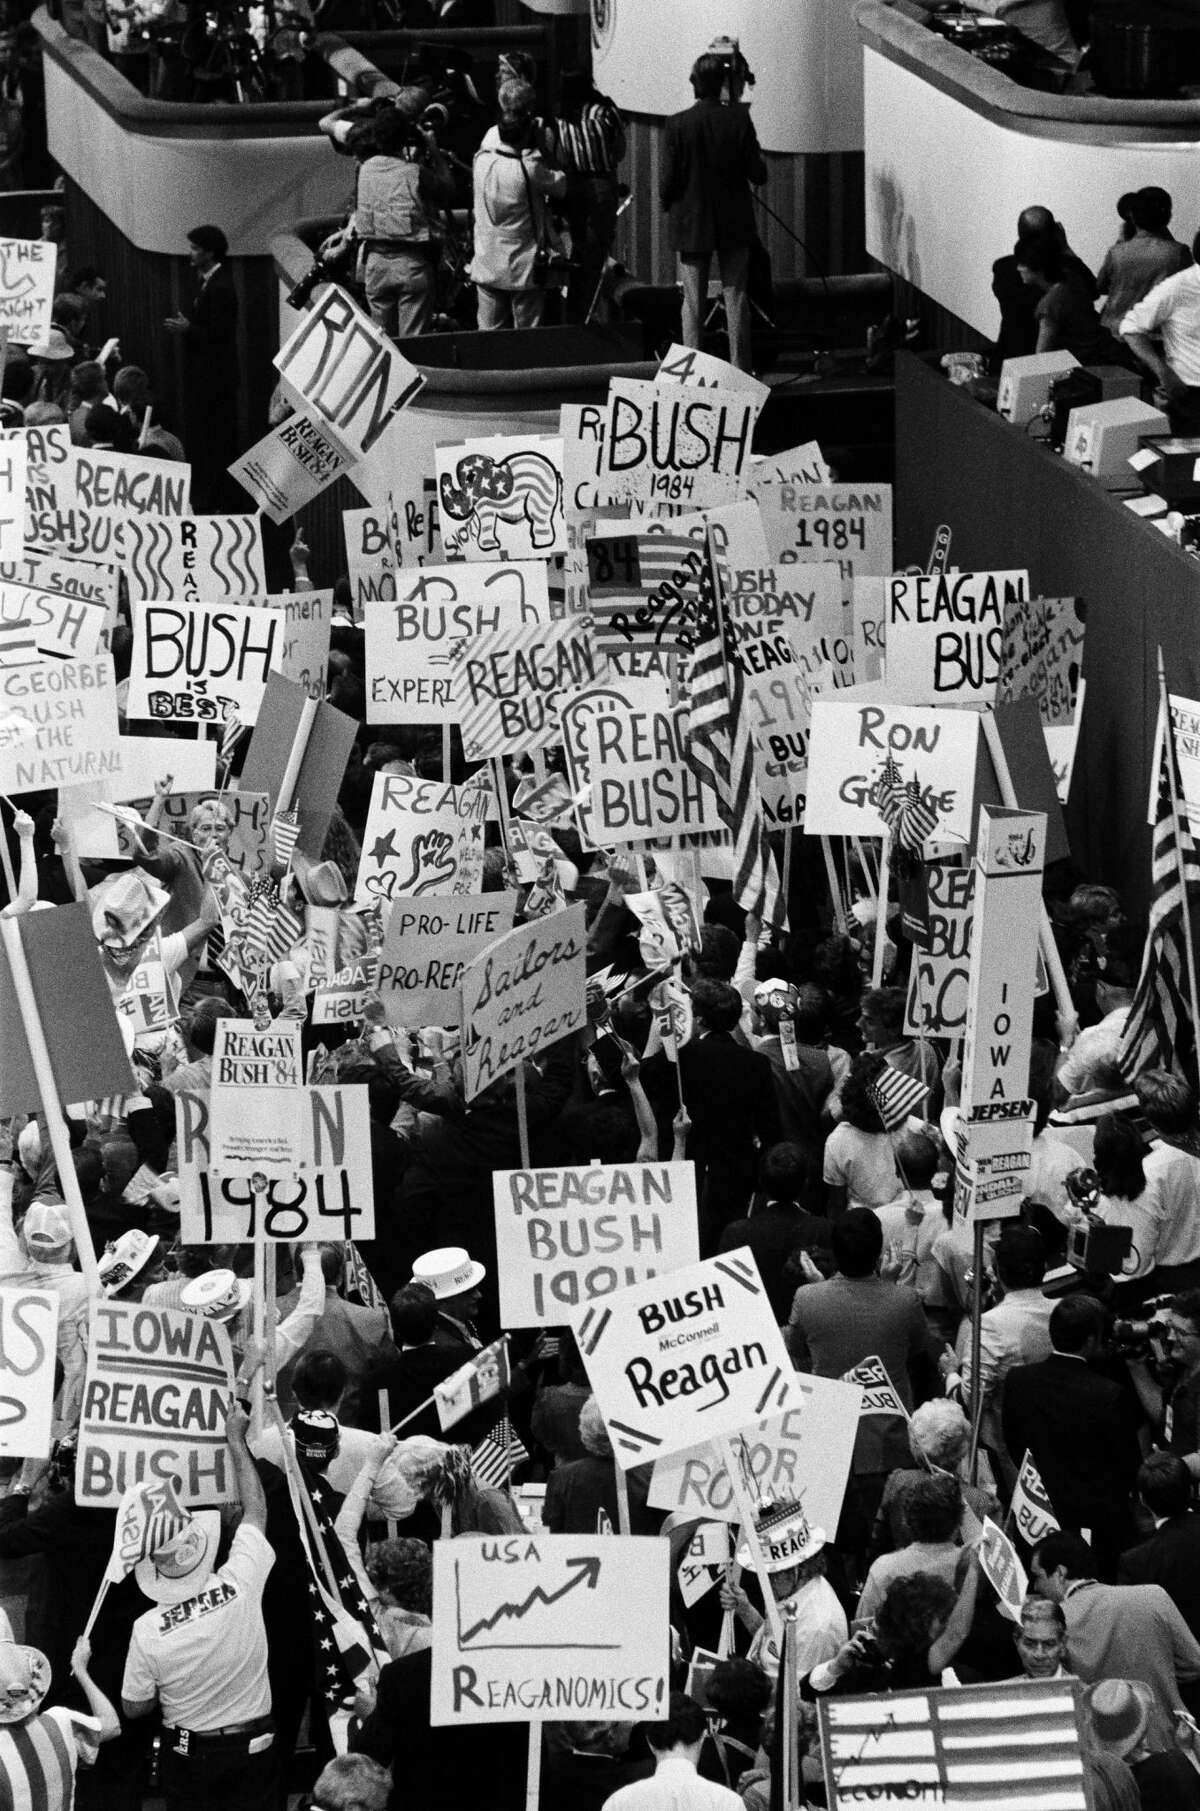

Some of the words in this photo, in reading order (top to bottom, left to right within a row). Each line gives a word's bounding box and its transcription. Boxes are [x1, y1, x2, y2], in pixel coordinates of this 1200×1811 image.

[1, 242, 43, 262] THE
[294, 416, 344, 471] REAGAN
[608, 395, 751, 476] BUSH
[76, 457, 185, 517] REAGAN
[650, 472, 694, 499] 1984
[780, 486, 882, 512] REAGAN
[795, 517, 865, 550] 1984
[394, 604, 500, 642] BUSH
[730, 591, 815, 622] TODAY
[891, 574, 1024, 625] REAGAN
[145, 607, 277, 683] BUSH
[466, 634, 596, 706] REAGAN
[148, 690, 240, 720] BEST
[35, 725, 73, 750] THE
[381, 775, 490, 822] REAGAN
[601, 767, 704, 828] BUSH
[472, 937, 582, 1015] Sailors
[498, 981, 544, 1026] and
[223, 1031, 295, 1058] REAGAN
[989, 983, 1011, 1099] IOWA
[967, 1100, 1034, 1122] JEPSEN
[200, 1168, 362, 1242] 1984
[509, 1167, 672, 1216] REAGAN
[527, 1212, 663, 1261] BUSH
[638, 1283, 725, 1335] BUSH
[96, 1308, 224, 1366] IOWA
[659, 1322, 720, 1352] McConnell
[624, 1341, 768, 1412] Reagan
[84, 1380, 234, 1432] REAGAN
[82, 1446, 227, 1498] BUSH
[481, 1540, 541, 1563] USA
[452, 1664, 664, 1714] REAGANOMICS!
